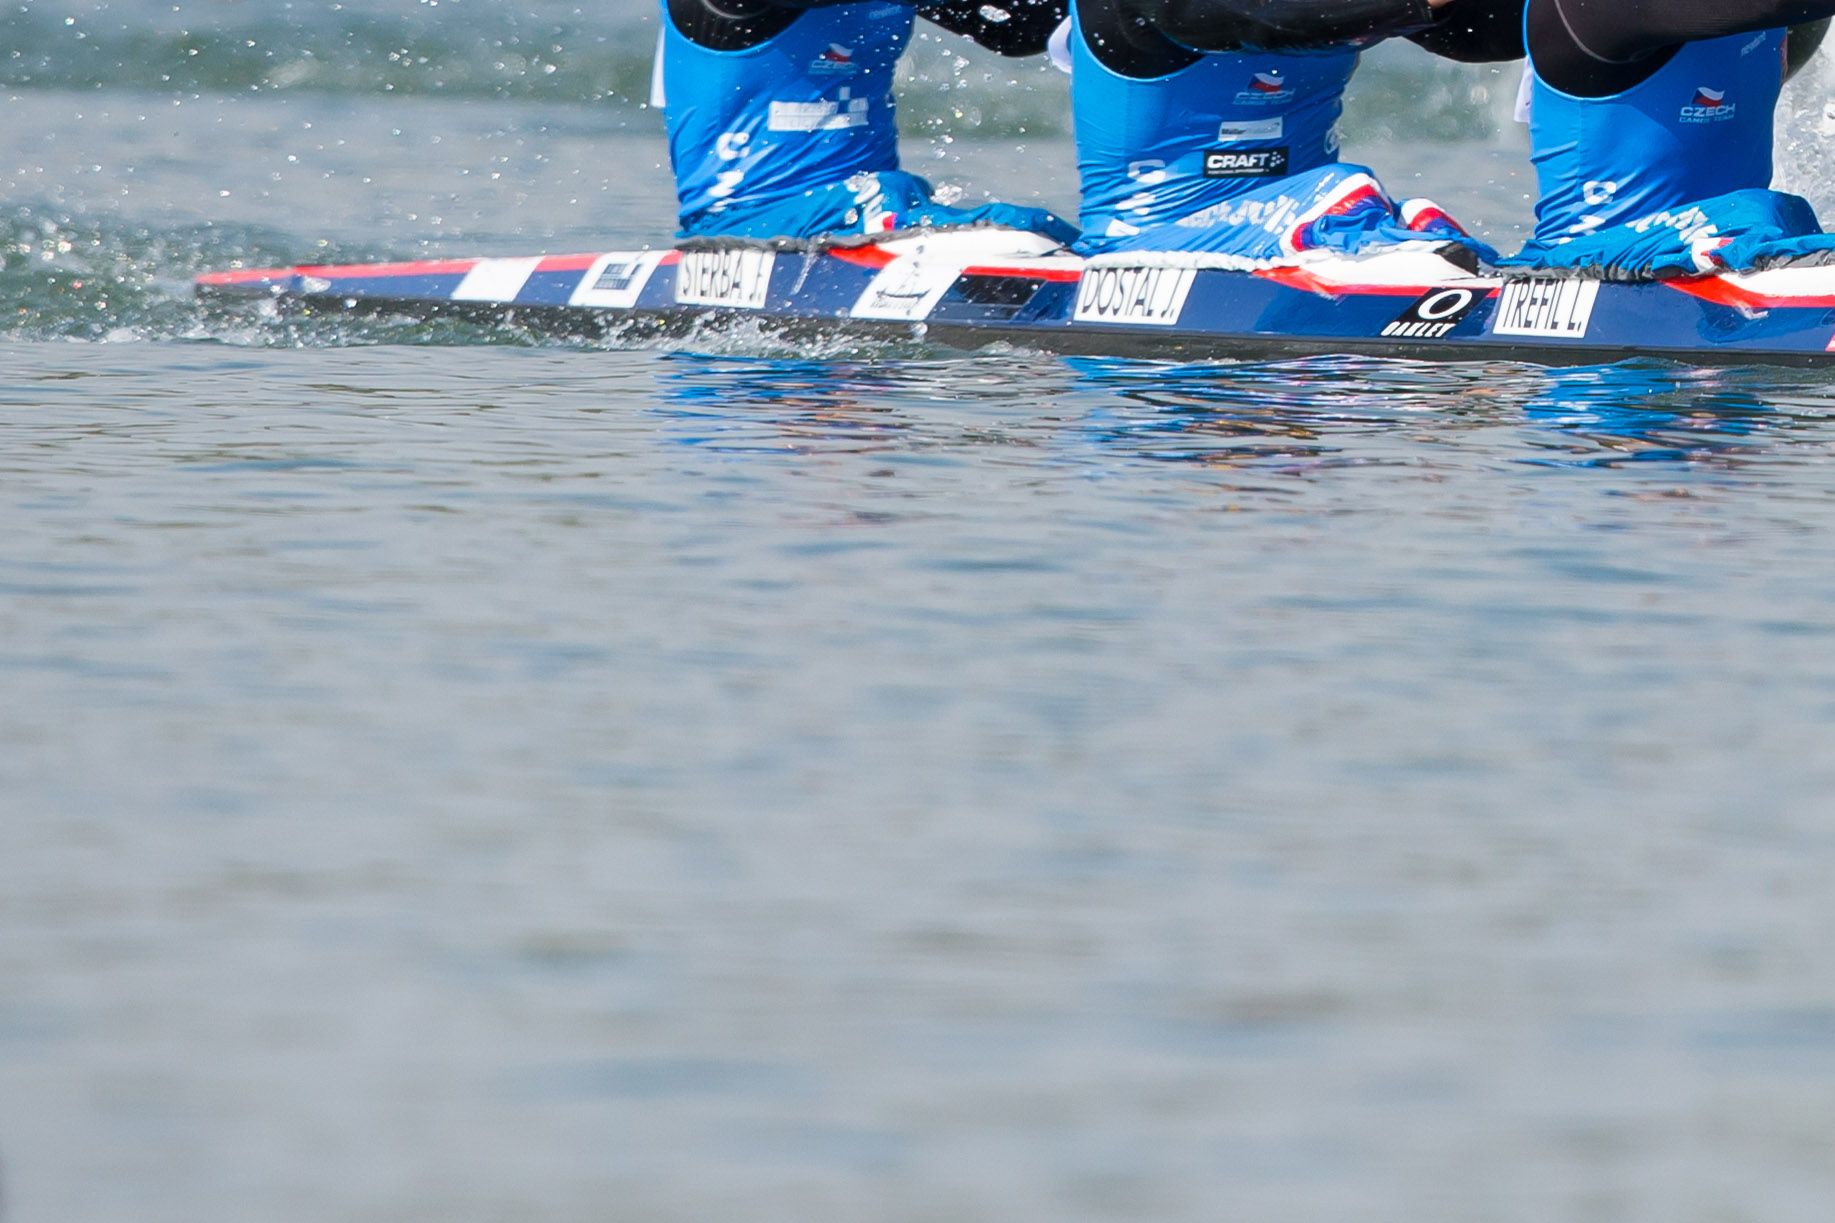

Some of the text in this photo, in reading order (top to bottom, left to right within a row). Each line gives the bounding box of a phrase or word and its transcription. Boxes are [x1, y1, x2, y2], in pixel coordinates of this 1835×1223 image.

[1681, 103, 1736, 117] CZECH
[1207, 153, 1270, 169] CRAFT
[1380, 321, 1457, 338] OAKLEY
